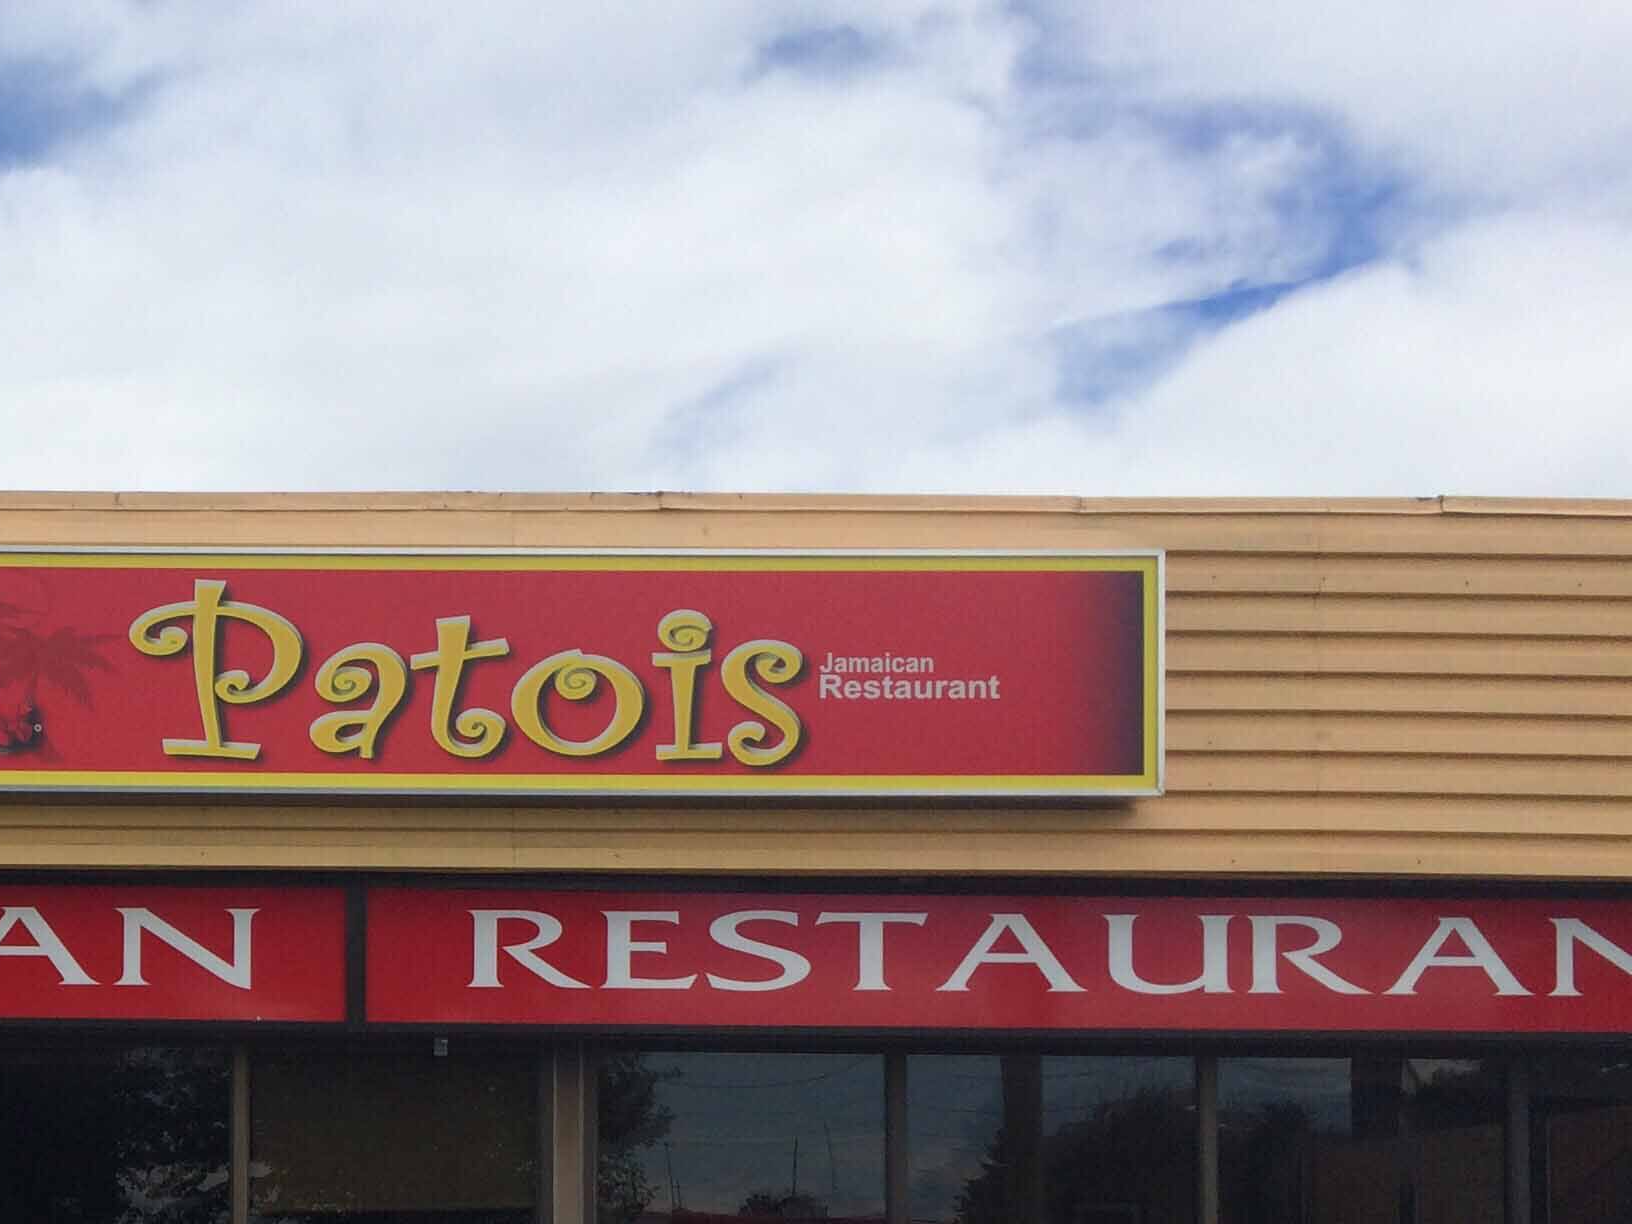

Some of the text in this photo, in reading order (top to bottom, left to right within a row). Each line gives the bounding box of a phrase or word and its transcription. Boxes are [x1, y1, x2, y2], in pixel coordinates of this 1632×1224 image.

[129, 579, 803, 766] Patois
[820, 652, 934, 673] Jamaican
[820, 674, 1000, 699] Restaurant
